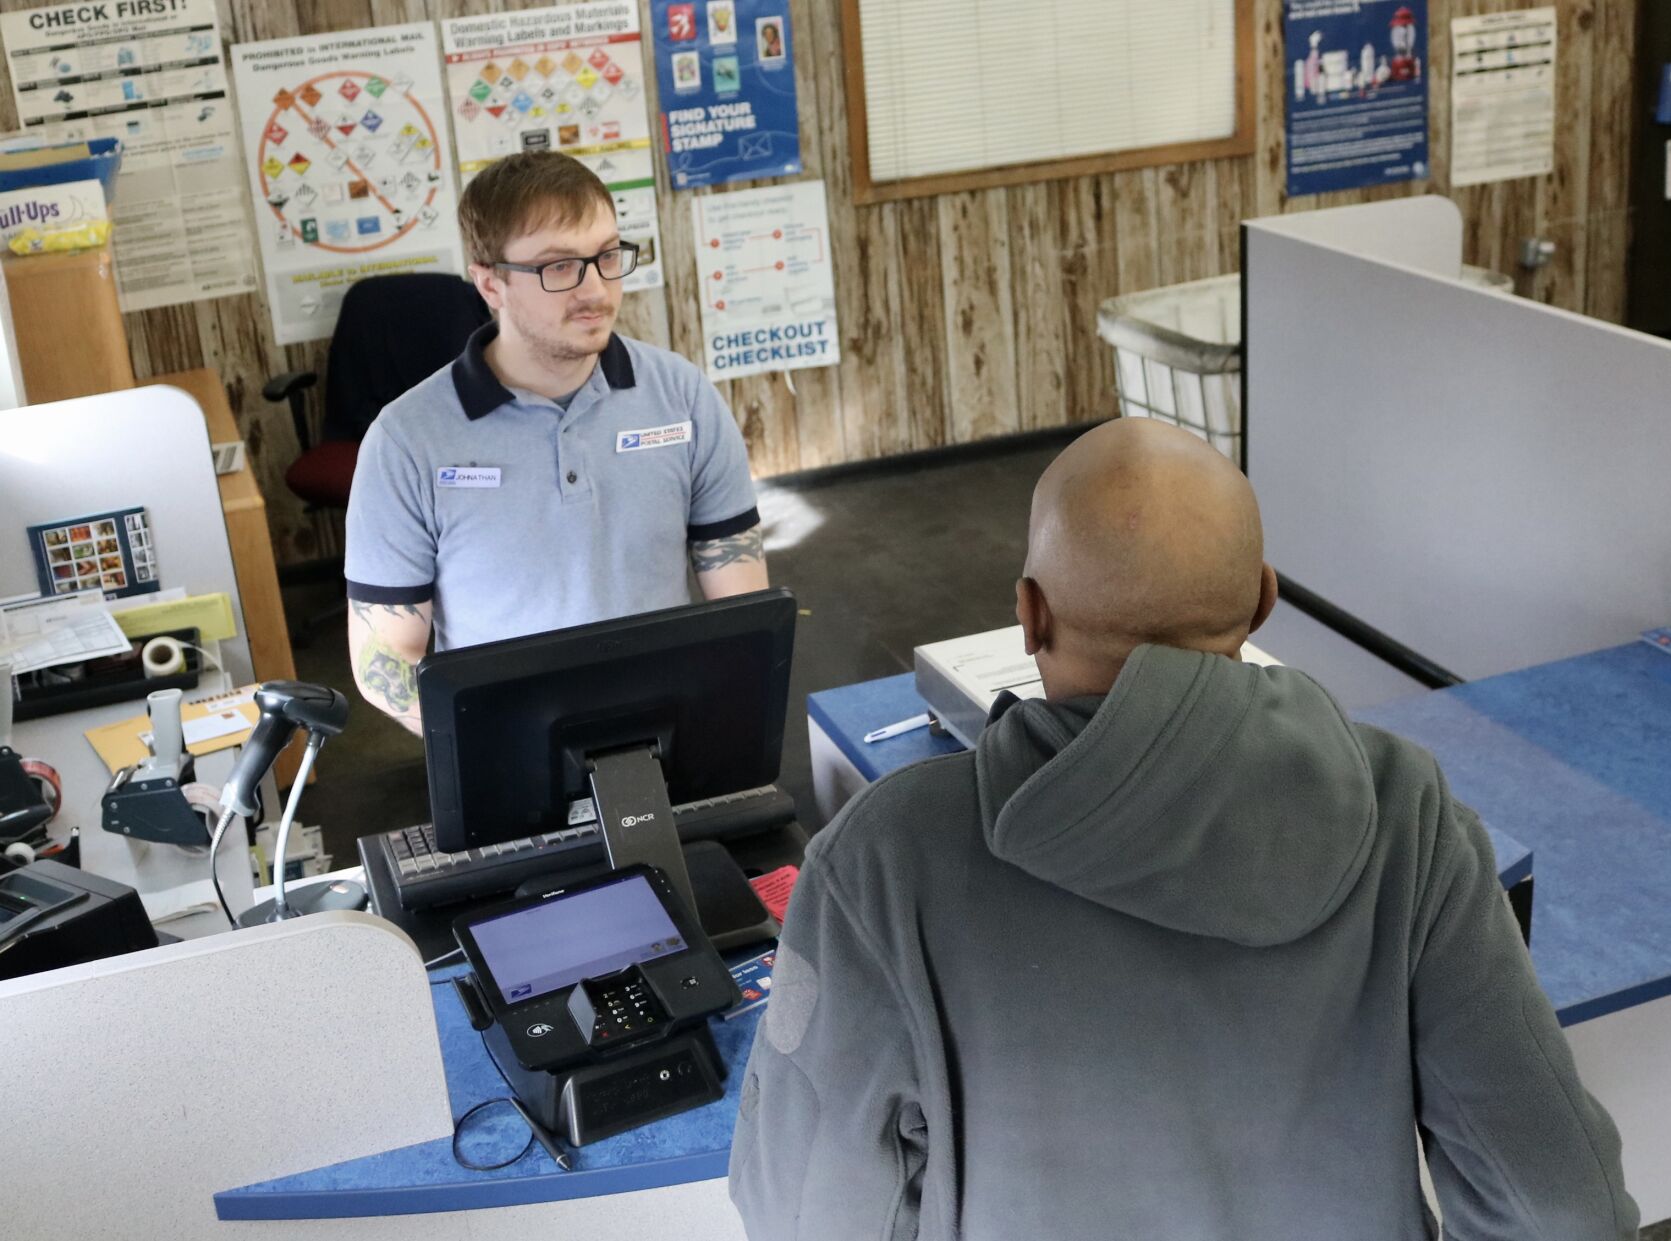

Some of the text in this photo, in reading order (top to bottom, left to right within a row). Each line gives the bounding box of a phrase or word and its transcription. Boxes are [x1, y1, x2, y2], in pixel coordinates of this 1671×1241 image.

[29, 0, 187, 29] CHECK FIRST!
[450, 5, 630, 35] Domestic Hazardous Materials
[242, 46, 304, 61] PROHIBITED
[318, 36, 397, 53] INTERNATIONAL
[401, 32, 425, 42] MAIL
[453, 33, 504, 48] Warning
[507, 26, 545, 42] Labels
[550, 24, 571, 37] and
[574, 18, 629, 34] Markings
[252, 45, 416, 72] Dangerous Goods Warning Labels
[669, 102, 752, 124] FIND YOUR
[670, 114, 756, 138] SIGNATURE
[672, 132, 724, 153] STAMP
[0, 201, 60, 229] ull-Ups
[712, 320, 826, 351] CHECKOUT
[714, 339, 829, 369] CHECKLIST
[663, 434, 685, 443] SERVICE
[664, 426, 684, 434] STATES
[637, 813, 655, 823] NCR
